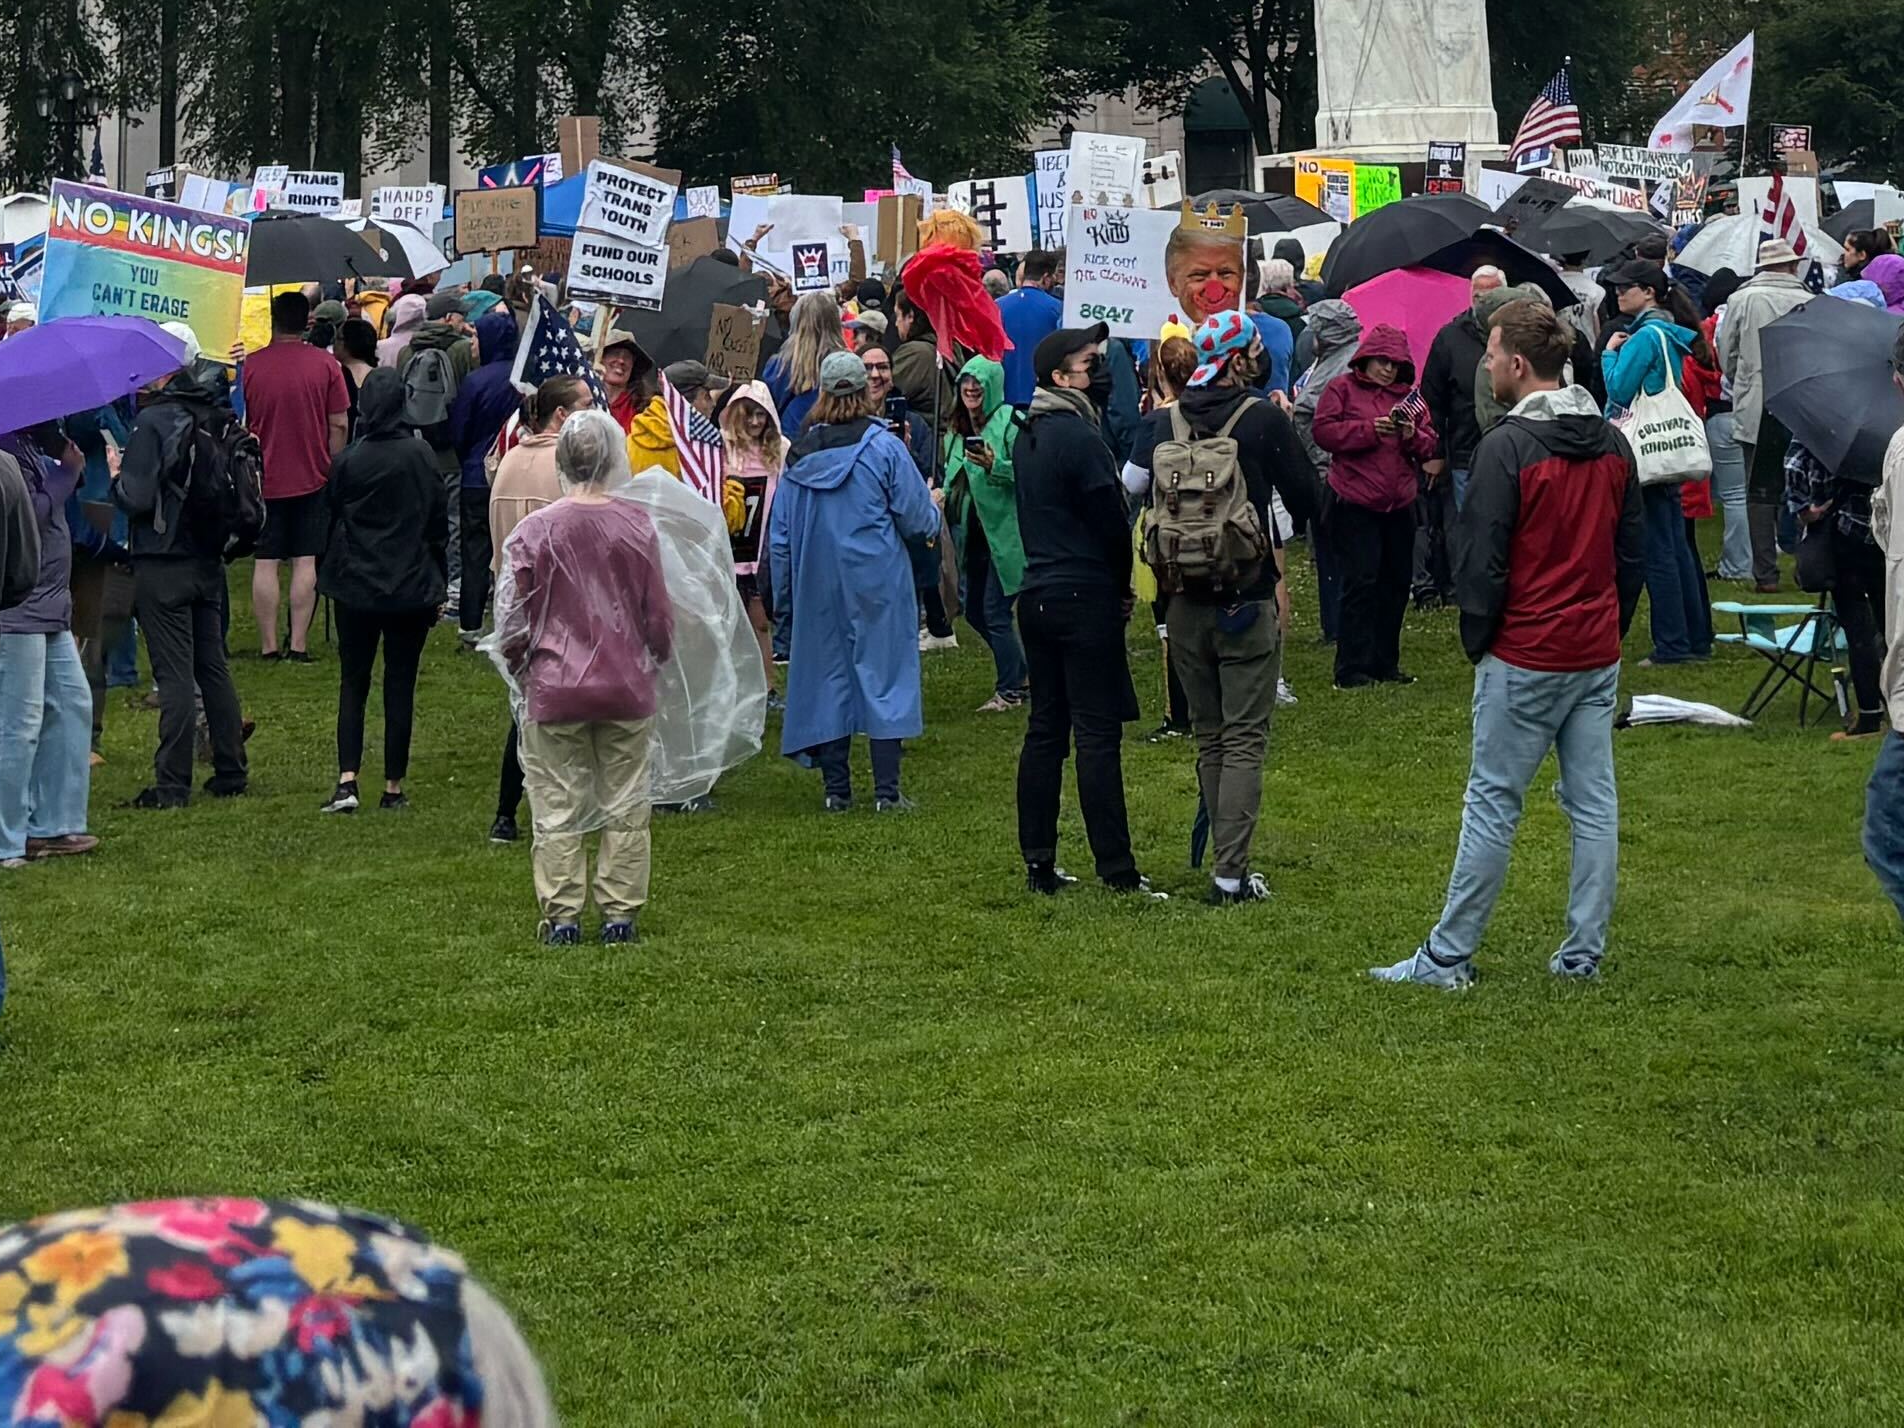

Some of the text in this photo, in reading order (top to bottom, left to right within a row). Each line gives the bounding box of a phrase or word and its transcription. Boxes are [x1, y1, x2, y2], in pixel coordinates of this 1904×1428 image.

[1298, 161, 1318, 173] NO
[292, 174, 339, 186] TRANS
[597, 170, 668, 203] PROTECT
[287, 195, 340, 207] RIGHTS
[383, 190, 434, 204] HANDS
[604, 190, 653, 217] TRANS
[1612, 187, 1644, 210] LIARS
[393, 206, 430, 220] OFF!
[601, 207, 648, 234] YOUTH
[55, 194, 246, 264] NO KINGS!
[582, 243, 624, 260] FUND
[627, 250, 659, 266] OUR
[131, 264, 160, 286] YOU
[580, 264, 654, 285] SCHOOLS
[92, 283, 191, 319] CAN'T ERASE
[1079, 303, 1135, 324] 8647
[1637, 417, 1692, 440] CULTIVATE
[1639, 435, 1696, 457] KINDNESS
